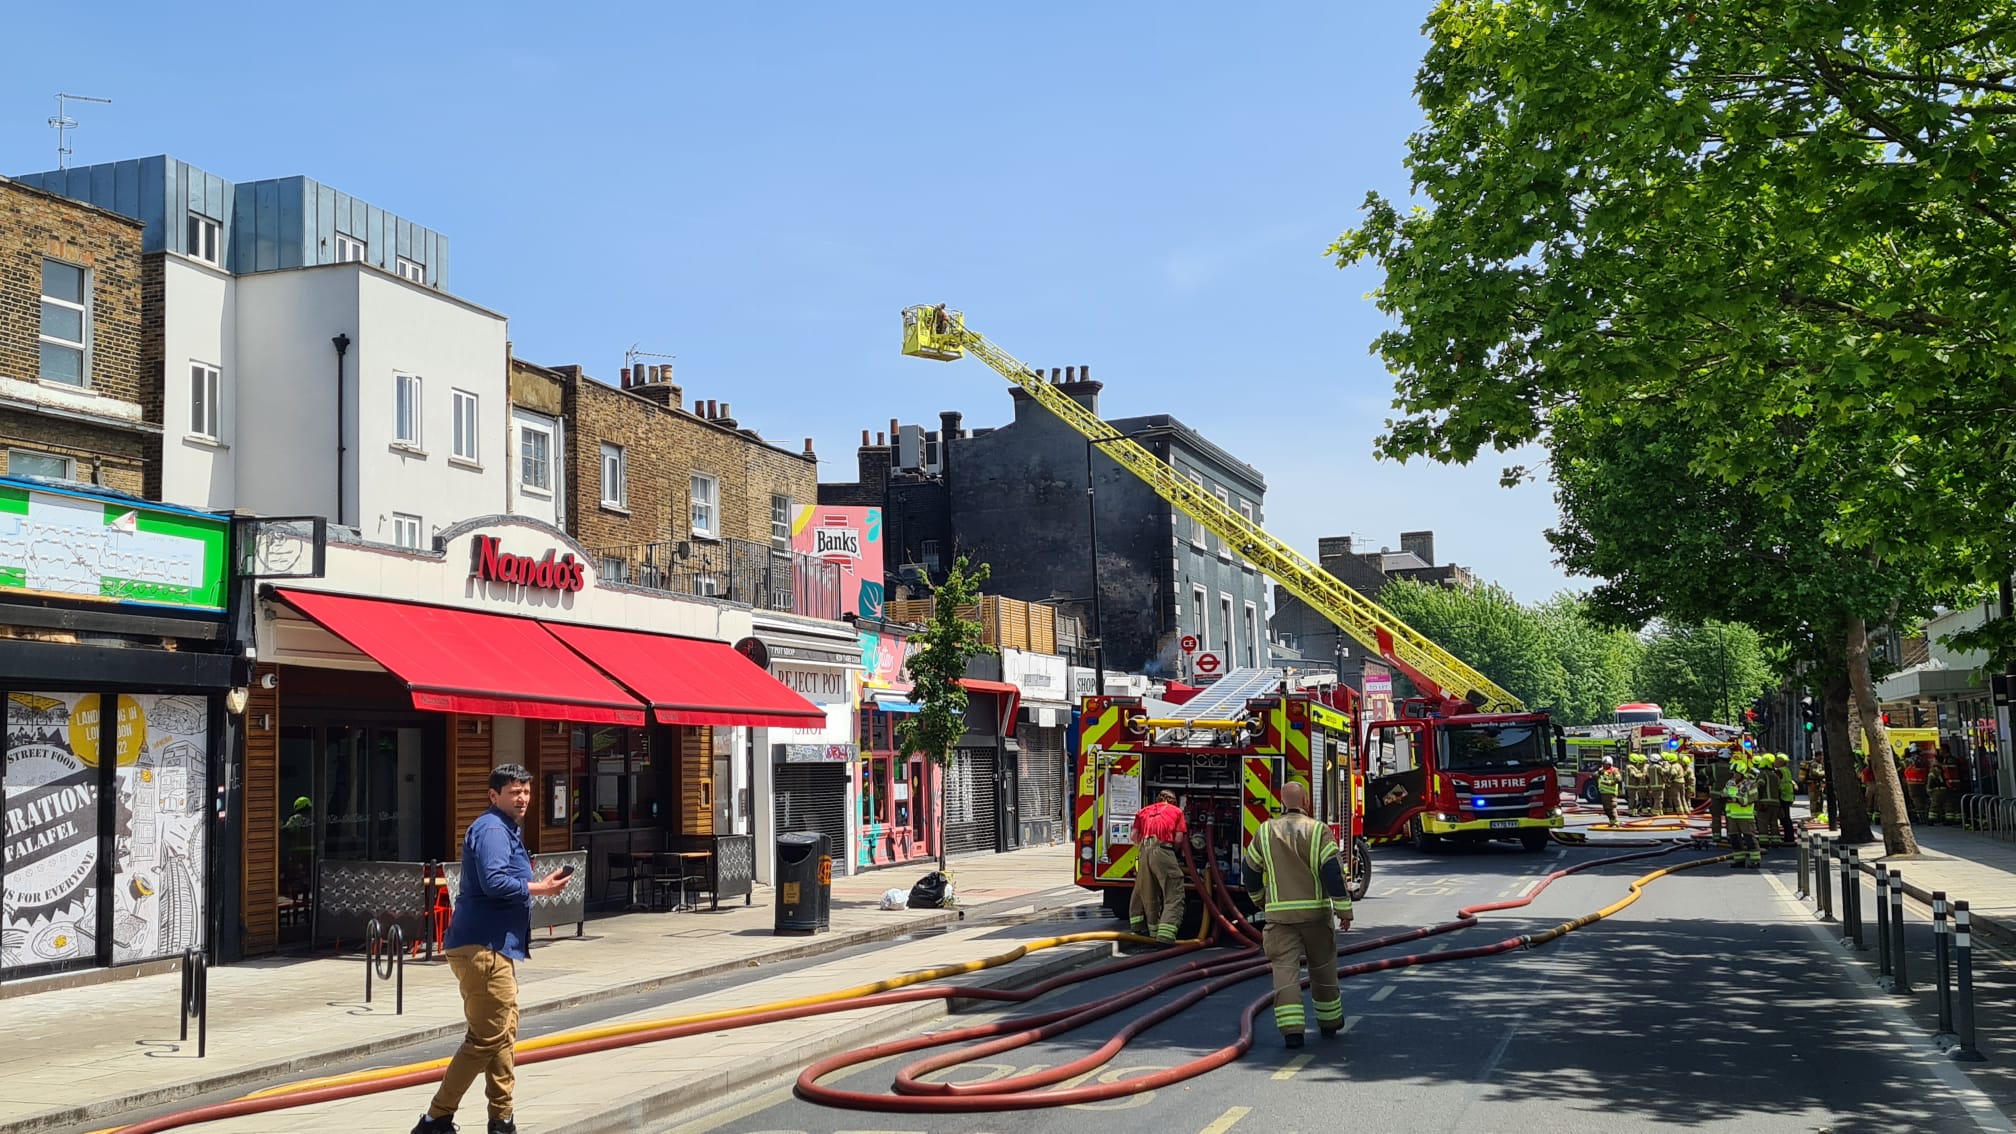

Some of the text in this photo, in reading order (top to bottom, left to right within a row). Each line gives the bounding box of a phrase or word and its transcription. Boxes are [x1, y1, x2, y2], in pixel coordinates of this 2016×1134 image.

[817, 530, 857, 554] Banks
[474, 534, 586, 592] Nando's
[1183, 639, 1195, 648] CE
[777, 669, 842, 695] REJECT POT
[1076, 677, 1096, 693] SHOP
[7, 747, 77, 771] STREET FOOD
[1501, 778, 1526, 788] FIRE
[5, 820, 79, 864] FALAFEL
[17, 892, 41, 903] FOR
[45, 850, 96, 898] EVERYONE
